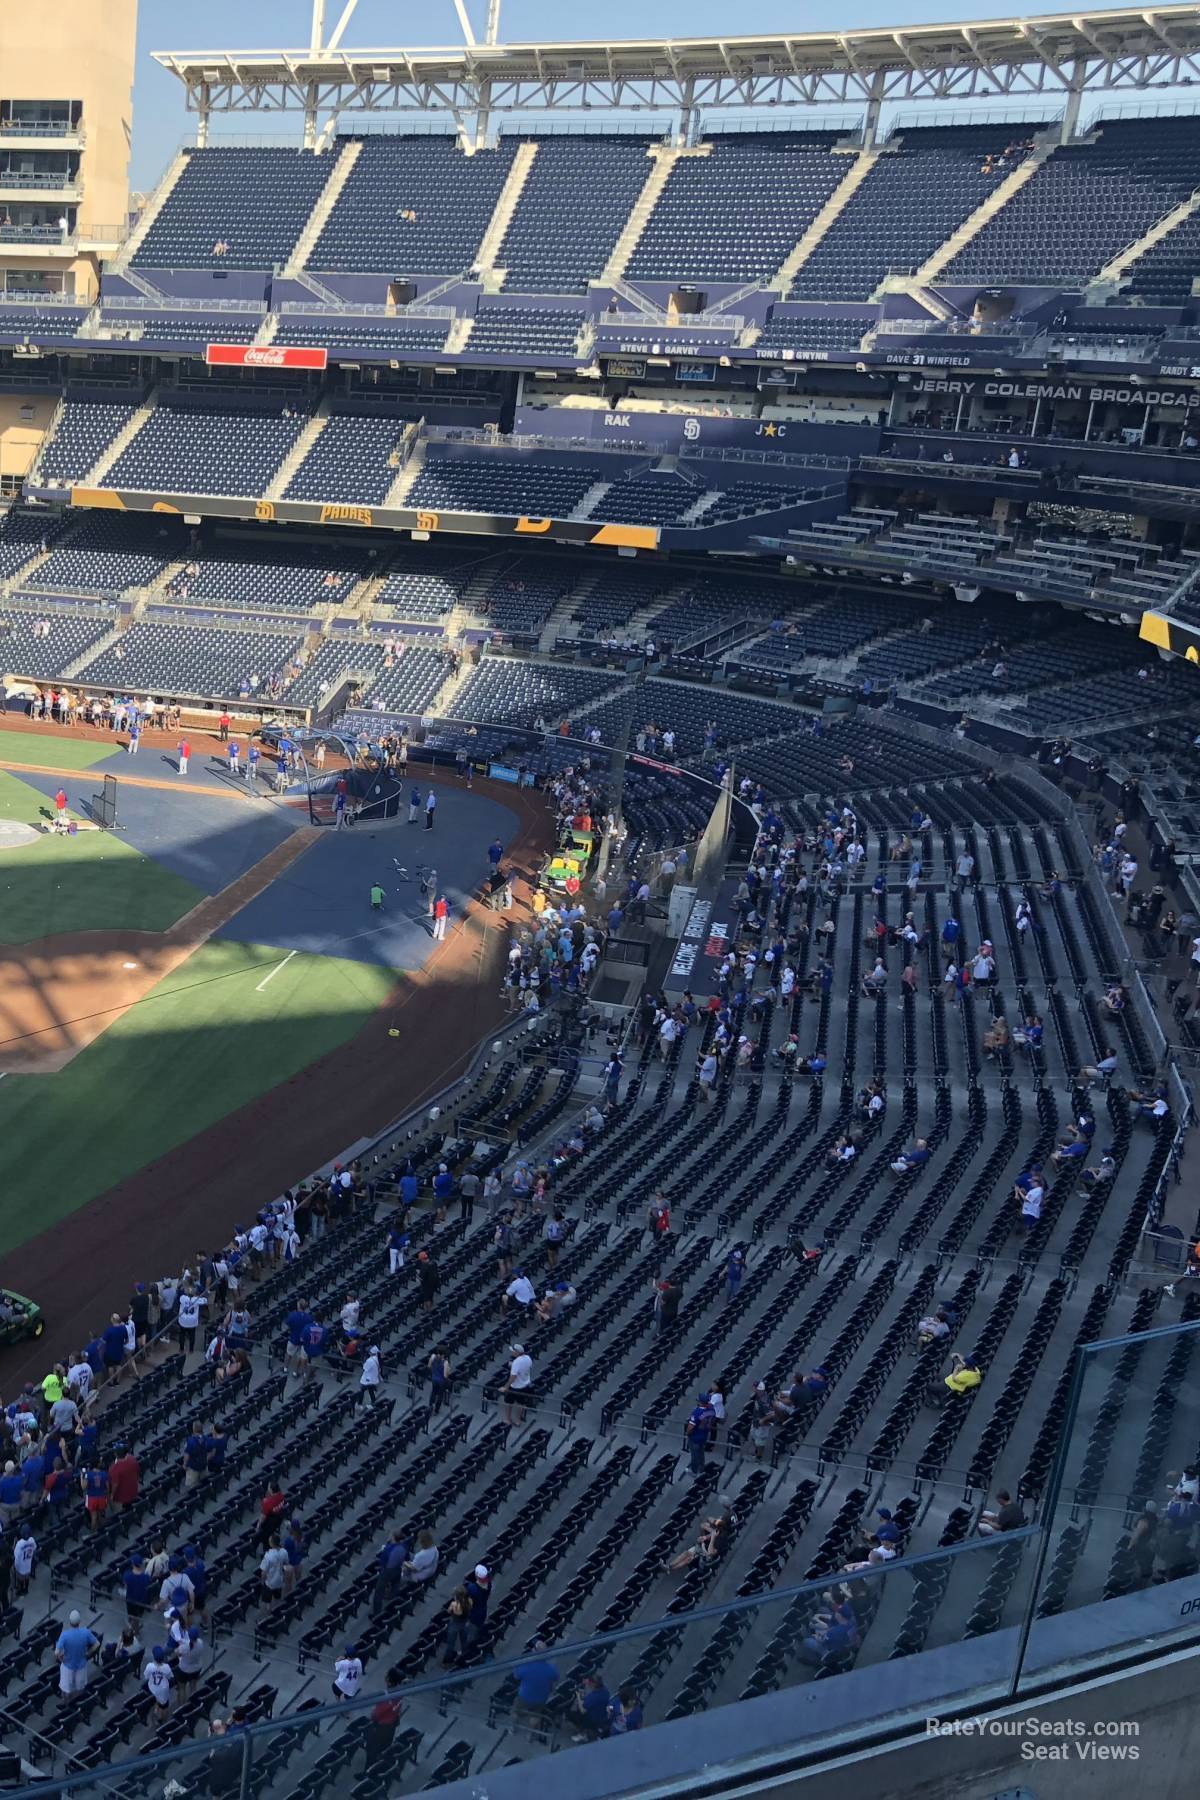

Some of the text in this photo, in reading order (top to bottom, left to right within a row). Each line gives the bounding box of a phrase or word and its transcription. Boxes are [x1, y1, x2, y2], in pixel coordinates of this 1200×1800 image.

[620, 344, 648, 353] STEVE
[664, 345, 699, 355] GARVEY
[756, 350, 778, 359] TONY
[795, 351, 828, 360] GWYNN
[886, 354, 970, 366] DAVE 31 WINFIELD
[1160, 365, 1188, 376] RANDY
[913, 380, 975, 394] JERRY
[984, 382, 1082, 400] COLEMAN
[604, 414, 631, 427] RAK
[320, 504, 372, 527] PADRES
[671, 942, 699, 976] WELCOME
